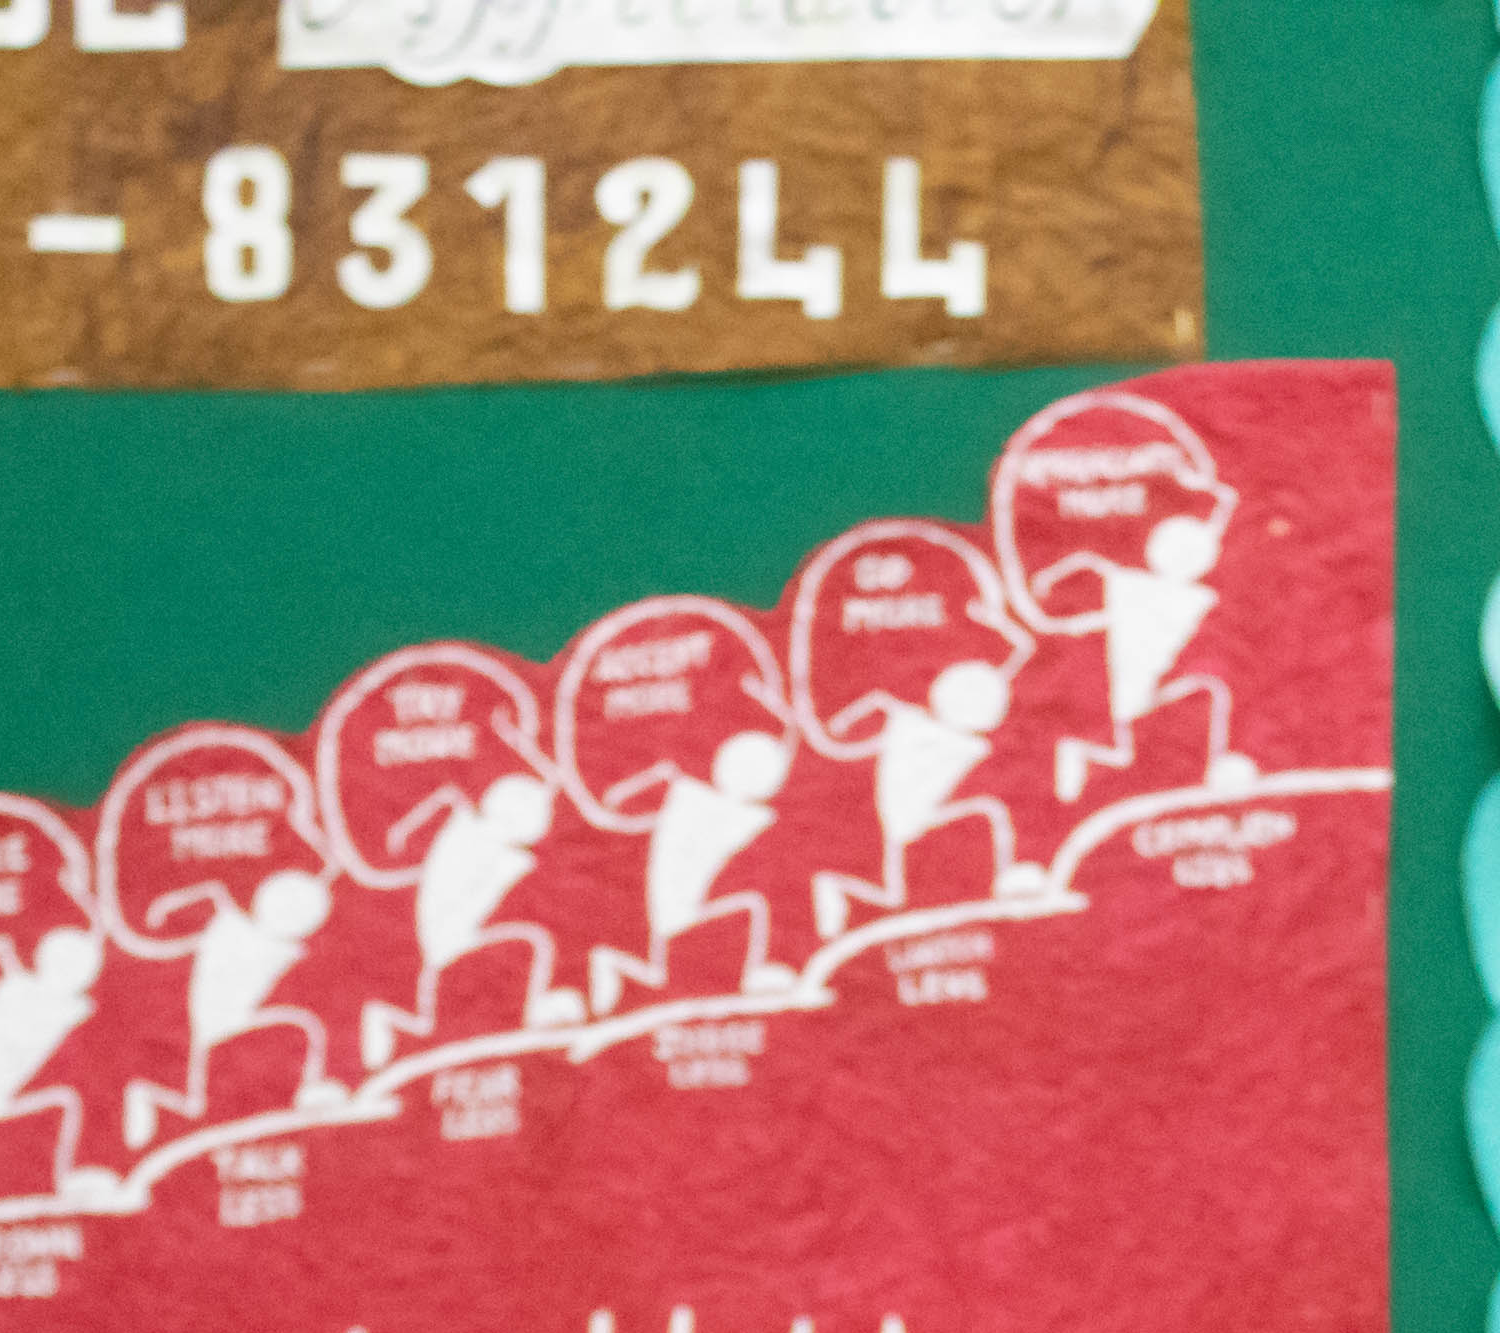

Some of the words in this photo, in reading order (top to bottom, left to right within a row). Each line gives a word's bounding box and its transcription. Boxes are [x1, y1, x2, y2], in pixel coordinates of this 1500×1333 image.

[200, 145, 988, 321] 831244
[842, 593, 946, 632] MORE
[374, 725, 477, 765] MORE
[145, 774, 285, 824] LISTEN
[171, 820, 270, 860] MORE
[212, 1141, 303, 1182] TALK
